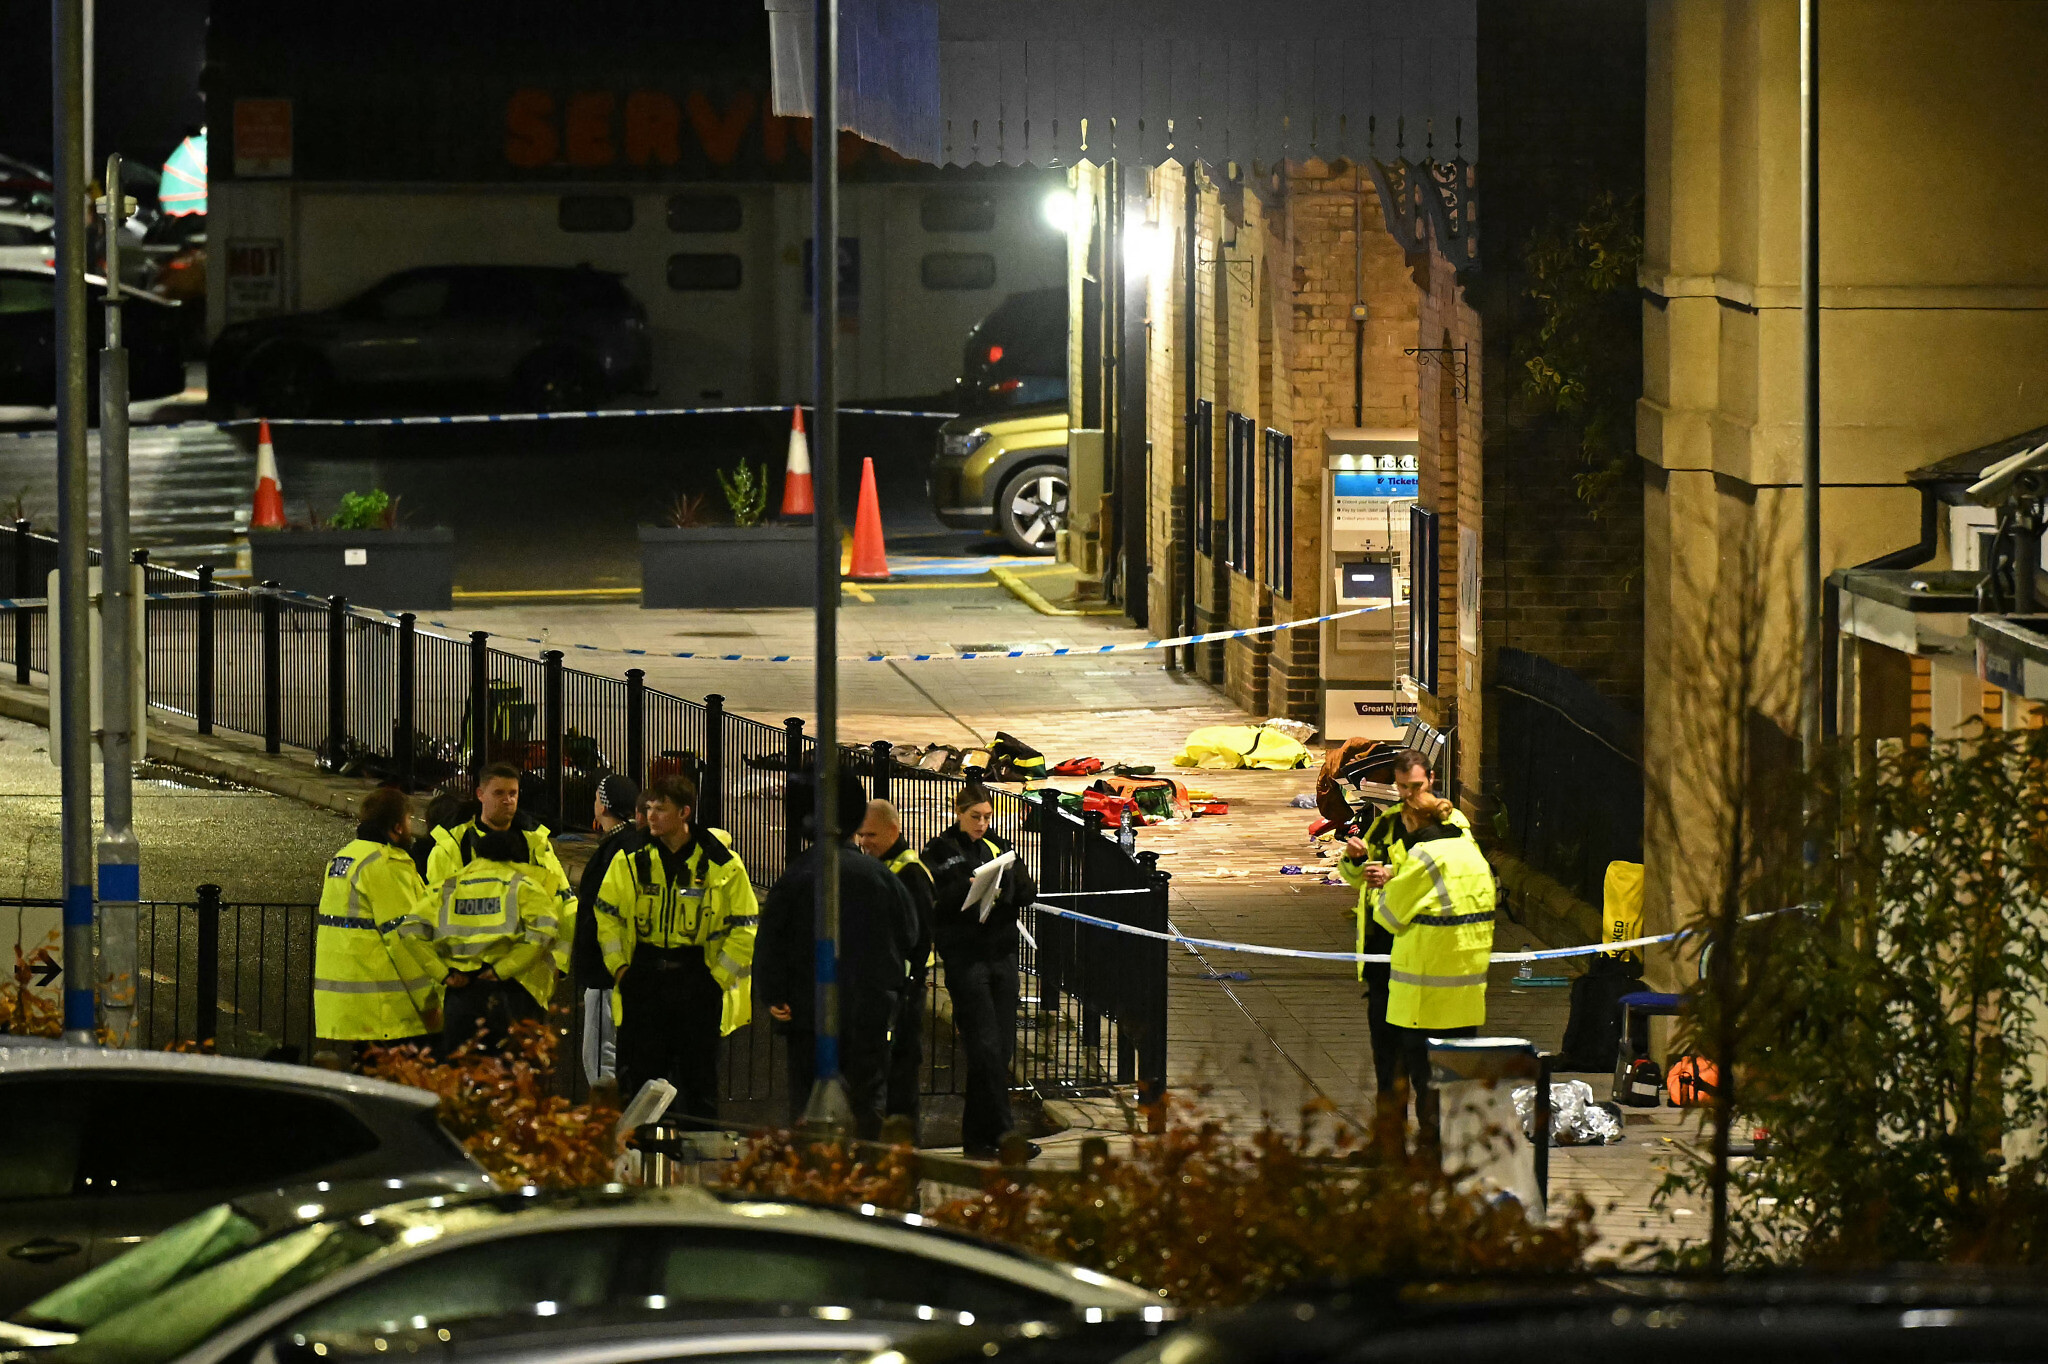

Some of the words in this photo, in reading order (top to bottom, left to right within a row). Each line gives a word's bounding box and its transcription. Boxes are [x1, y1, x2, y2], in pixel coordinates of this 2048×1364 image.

[505, 88, 920, 165] SERVI
[1373, 456, 1418, 468] Ticket
[1361, 704, 1384, 713] Great
[457, 898, 501, 914] POLICE
